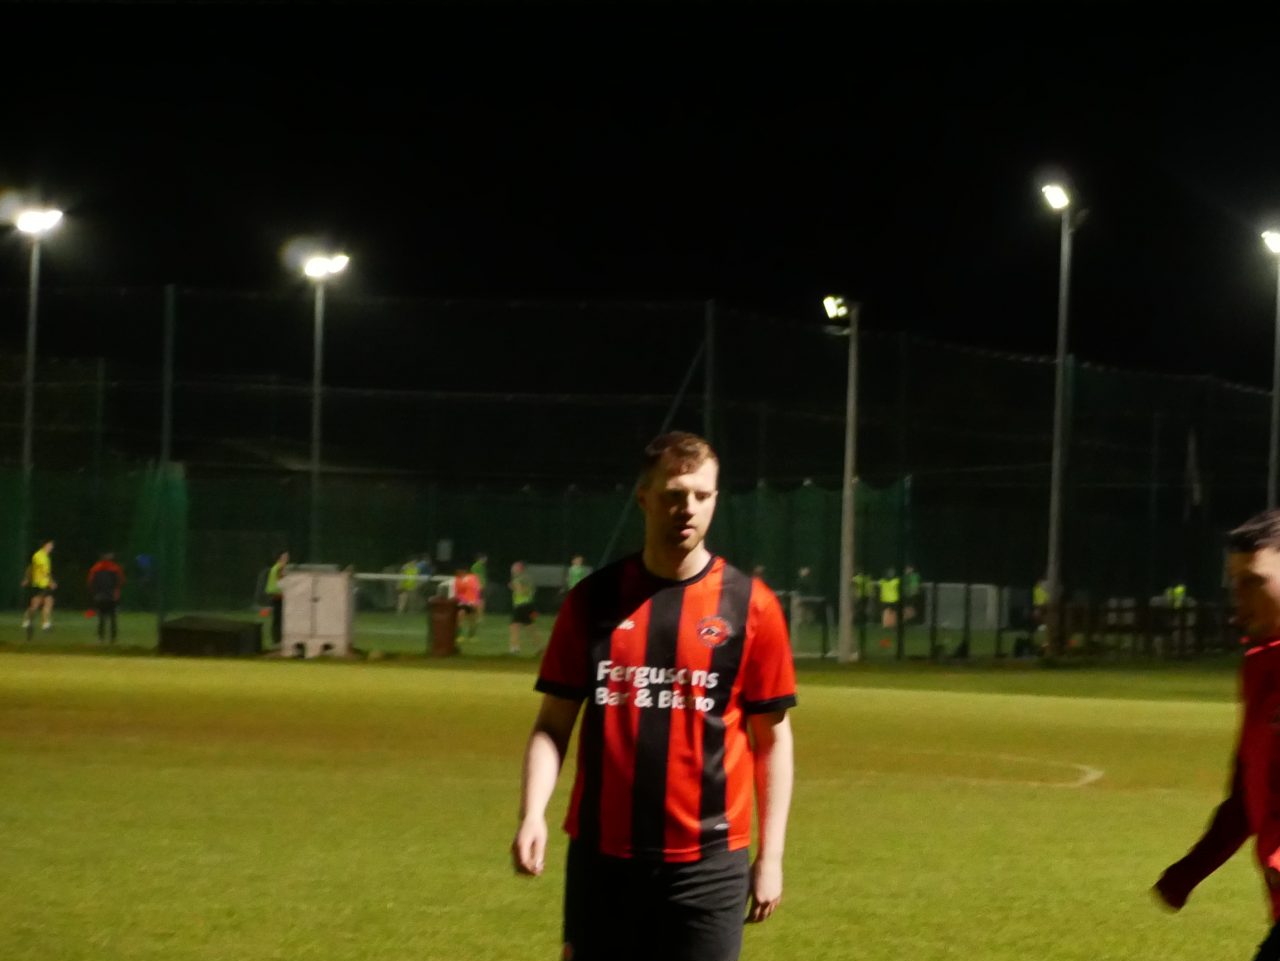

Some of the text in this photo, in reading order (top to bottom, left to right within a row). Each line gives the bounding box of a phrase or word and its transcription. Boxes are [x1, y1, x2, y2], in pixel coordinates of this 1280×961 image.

[596, 660, 720, 689] Fergusons
[634, 688, 654, 708] &
[658, 689, 716, 712] Bisro
